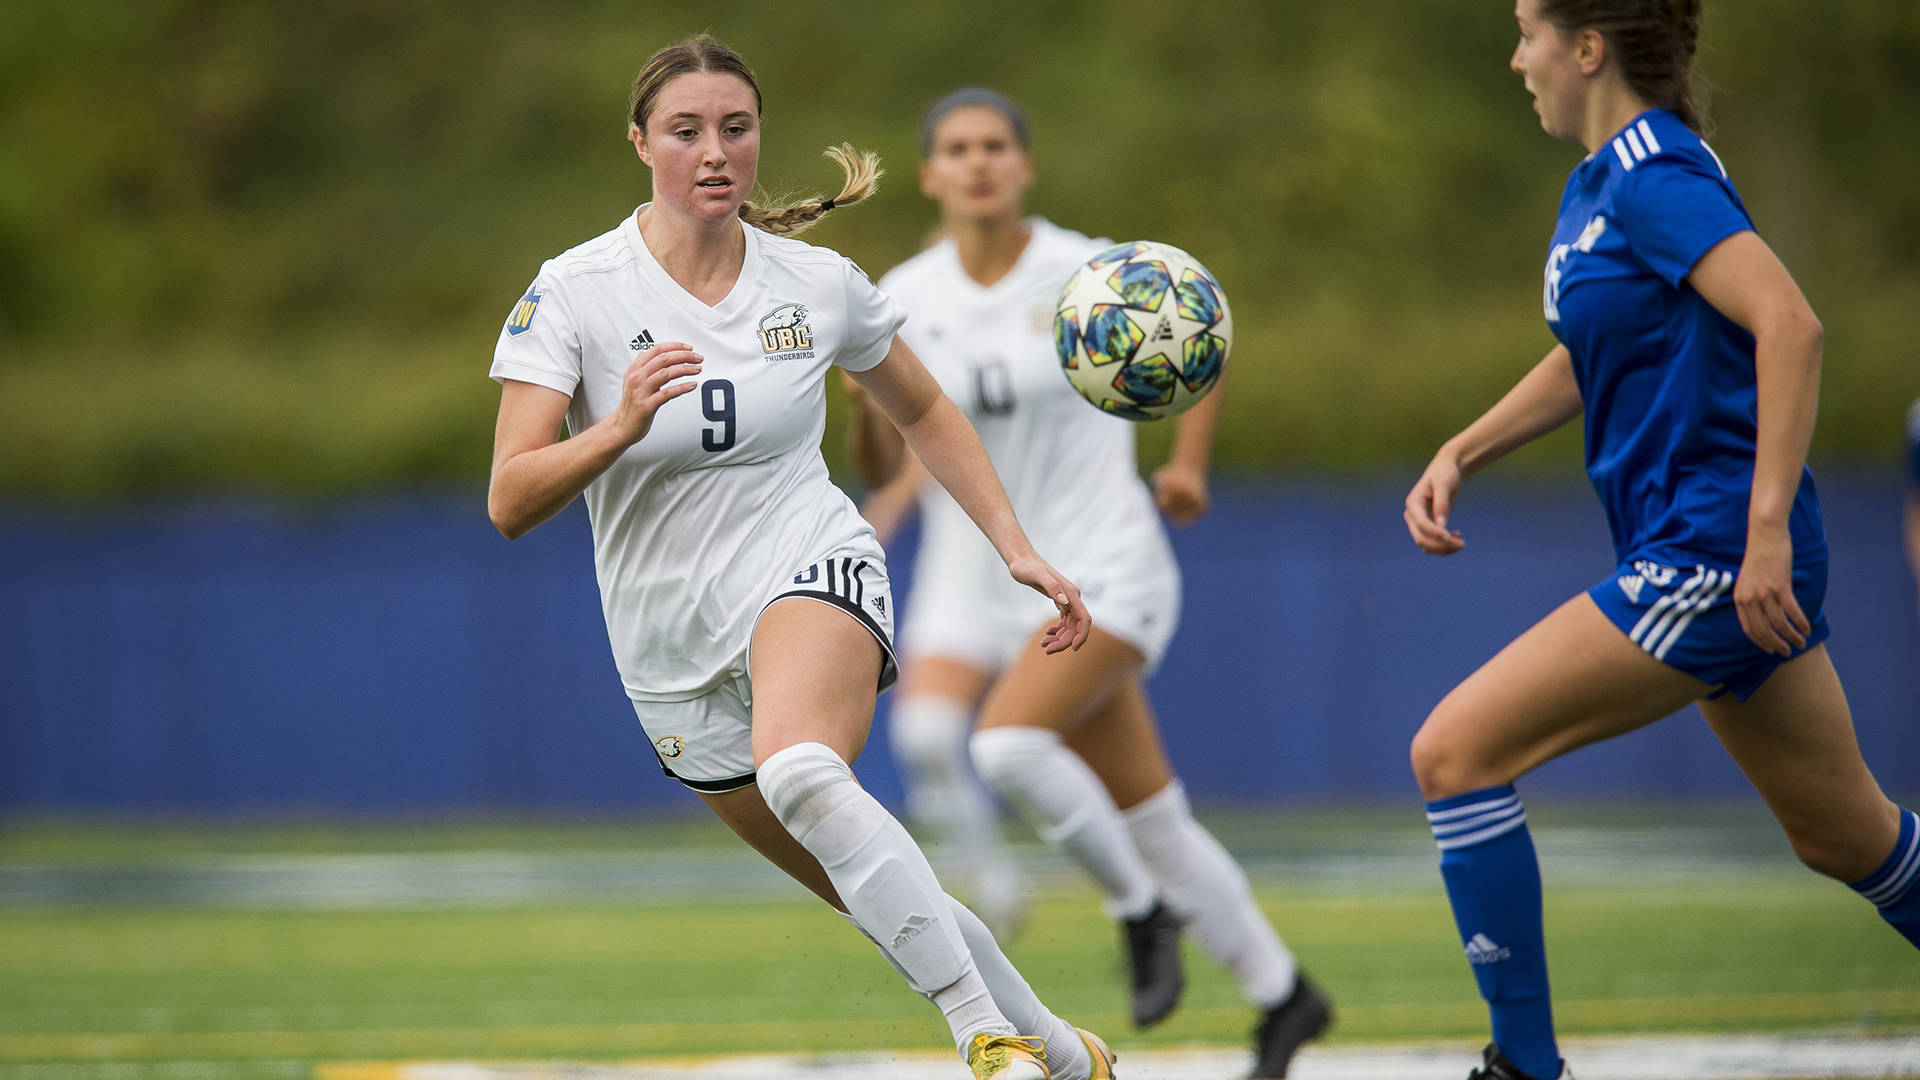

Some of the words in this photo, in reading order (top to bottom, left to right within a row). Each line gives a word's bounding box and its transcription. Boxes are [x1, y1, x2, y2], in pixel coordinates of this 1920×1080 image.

[629, 342, 655, 351] adida
[758, 325, 813, 353] UBC
[764, 351, 815, 362] THUNDERBIRDS
[967, 355, 1017, 418] 10
[701, 379, 736, 452] 9
[893, 915, 938, 949] adidas
